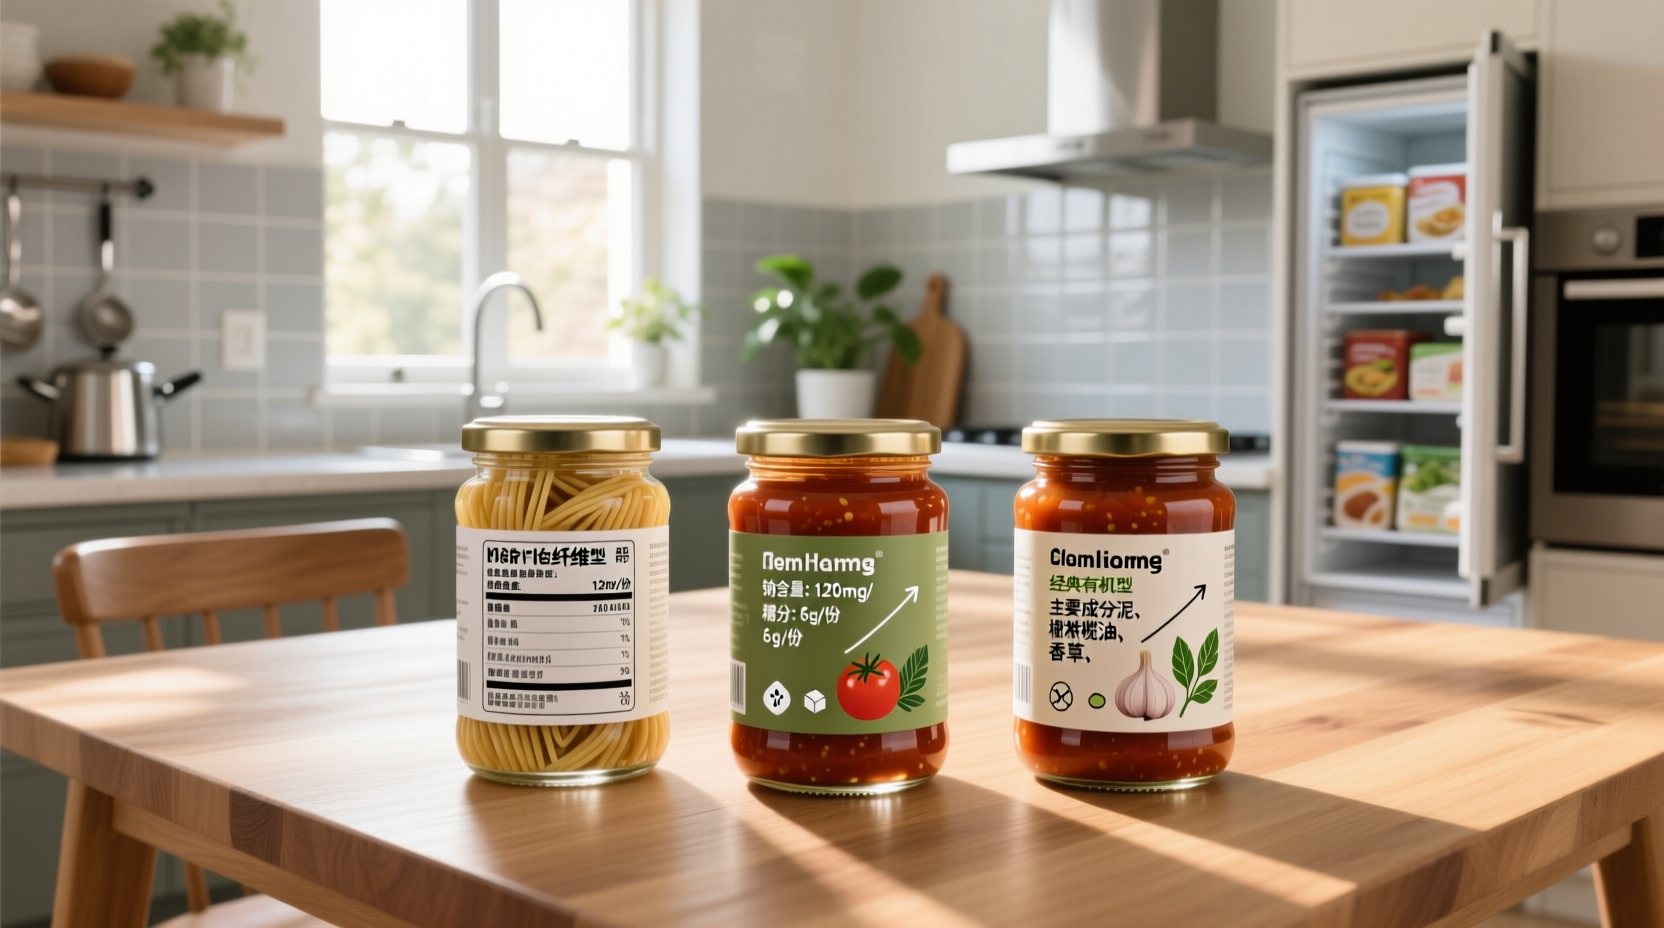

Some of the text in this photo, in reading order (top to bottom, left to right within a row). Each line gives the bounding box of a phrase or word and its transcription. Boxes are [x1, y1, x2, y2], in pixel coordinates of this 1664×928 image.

[1049, 574, 1134, 594] 经典有机型
[763, 628, 803, 648] 6g/份
